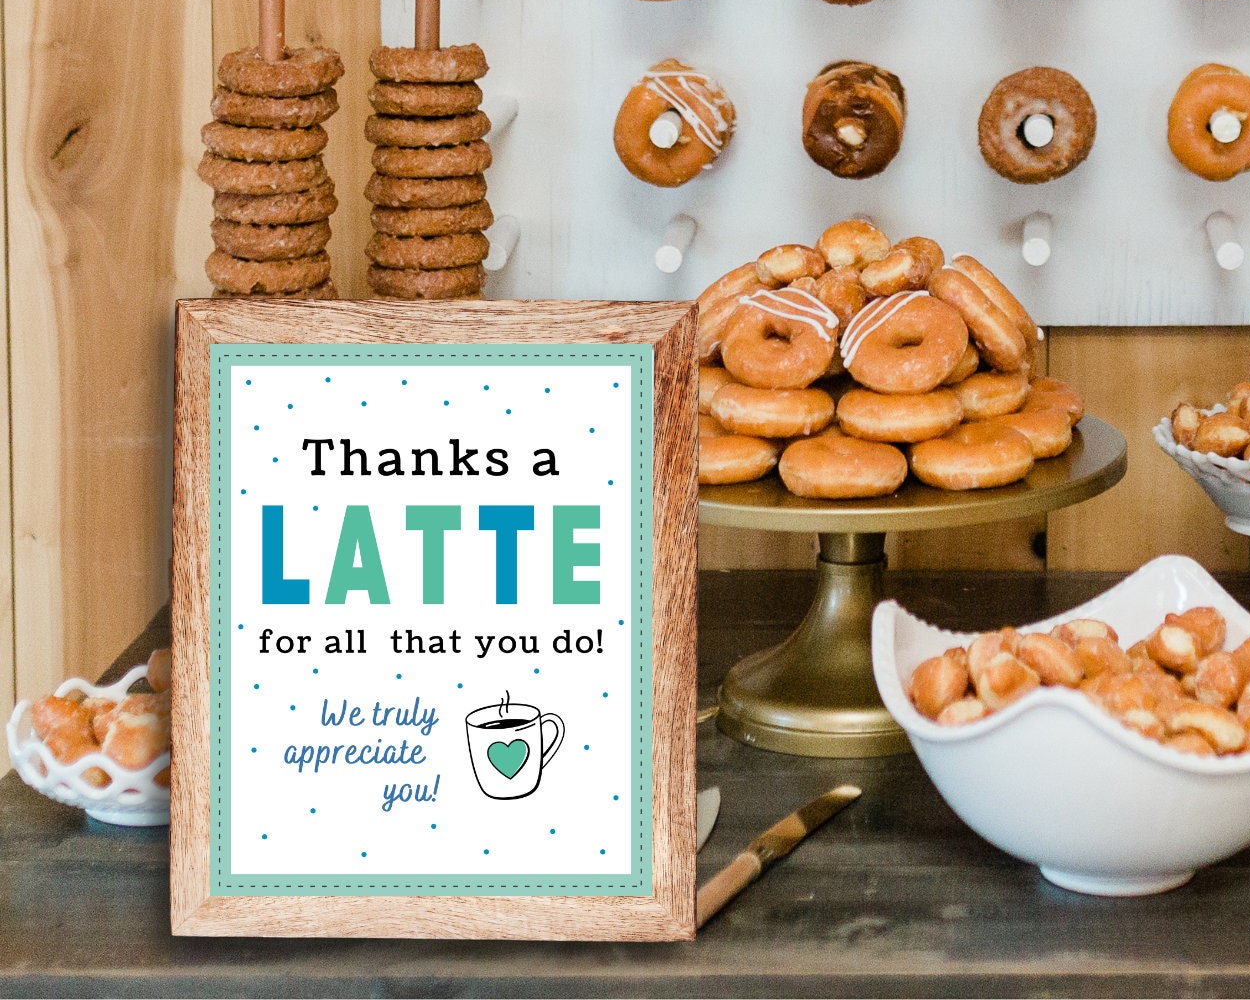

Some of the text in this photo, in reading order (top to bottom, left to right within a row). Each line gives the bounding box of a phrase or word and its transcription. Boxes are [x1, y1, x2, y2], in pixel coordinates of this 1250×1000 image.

[301, 438, 560, 477] Thanks a
[261, 504, 601, 605] LATTE
[258, 628, 604, 659] for all that you do!
[321, 696, 440, 736] We truly
[283, 738, 427, 773] appreciate
[381, 773, 441, 813] you!
